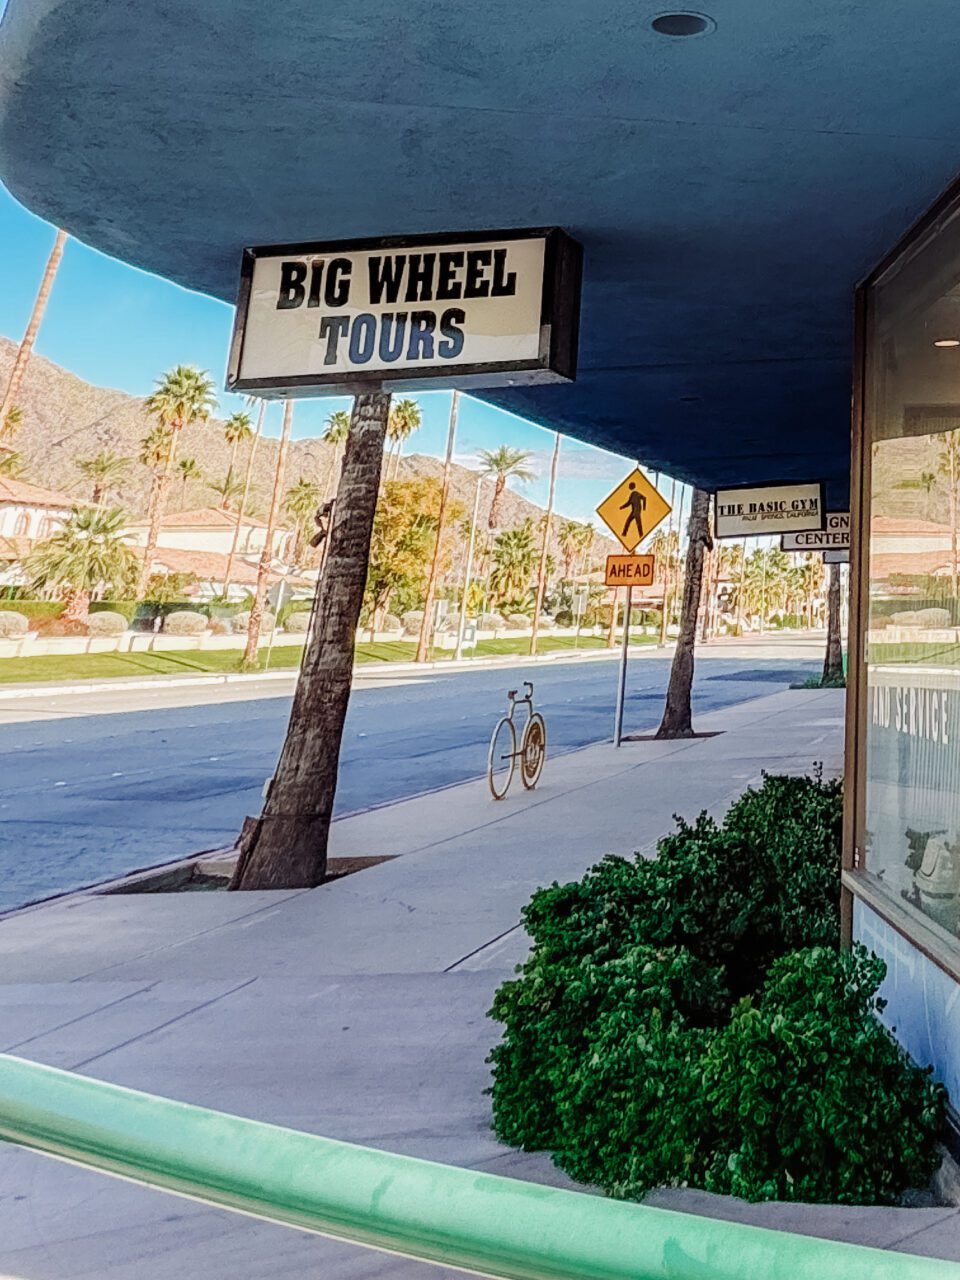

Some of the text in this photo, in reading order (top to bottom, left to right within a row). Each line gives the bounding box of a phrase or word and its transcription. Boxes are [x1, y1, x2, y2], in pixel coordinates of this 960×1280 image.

[276, 248, 517, 310] BIG WHEEL
[319, 308, 467, 366] TOURS
[718, 498, 818, 516] THE BASIC GYM
[795, 532, 850, 545] CENTER
[609, 563, 651, 578] AHEAD
[872, 686, 949, 745] AND SERVICE
